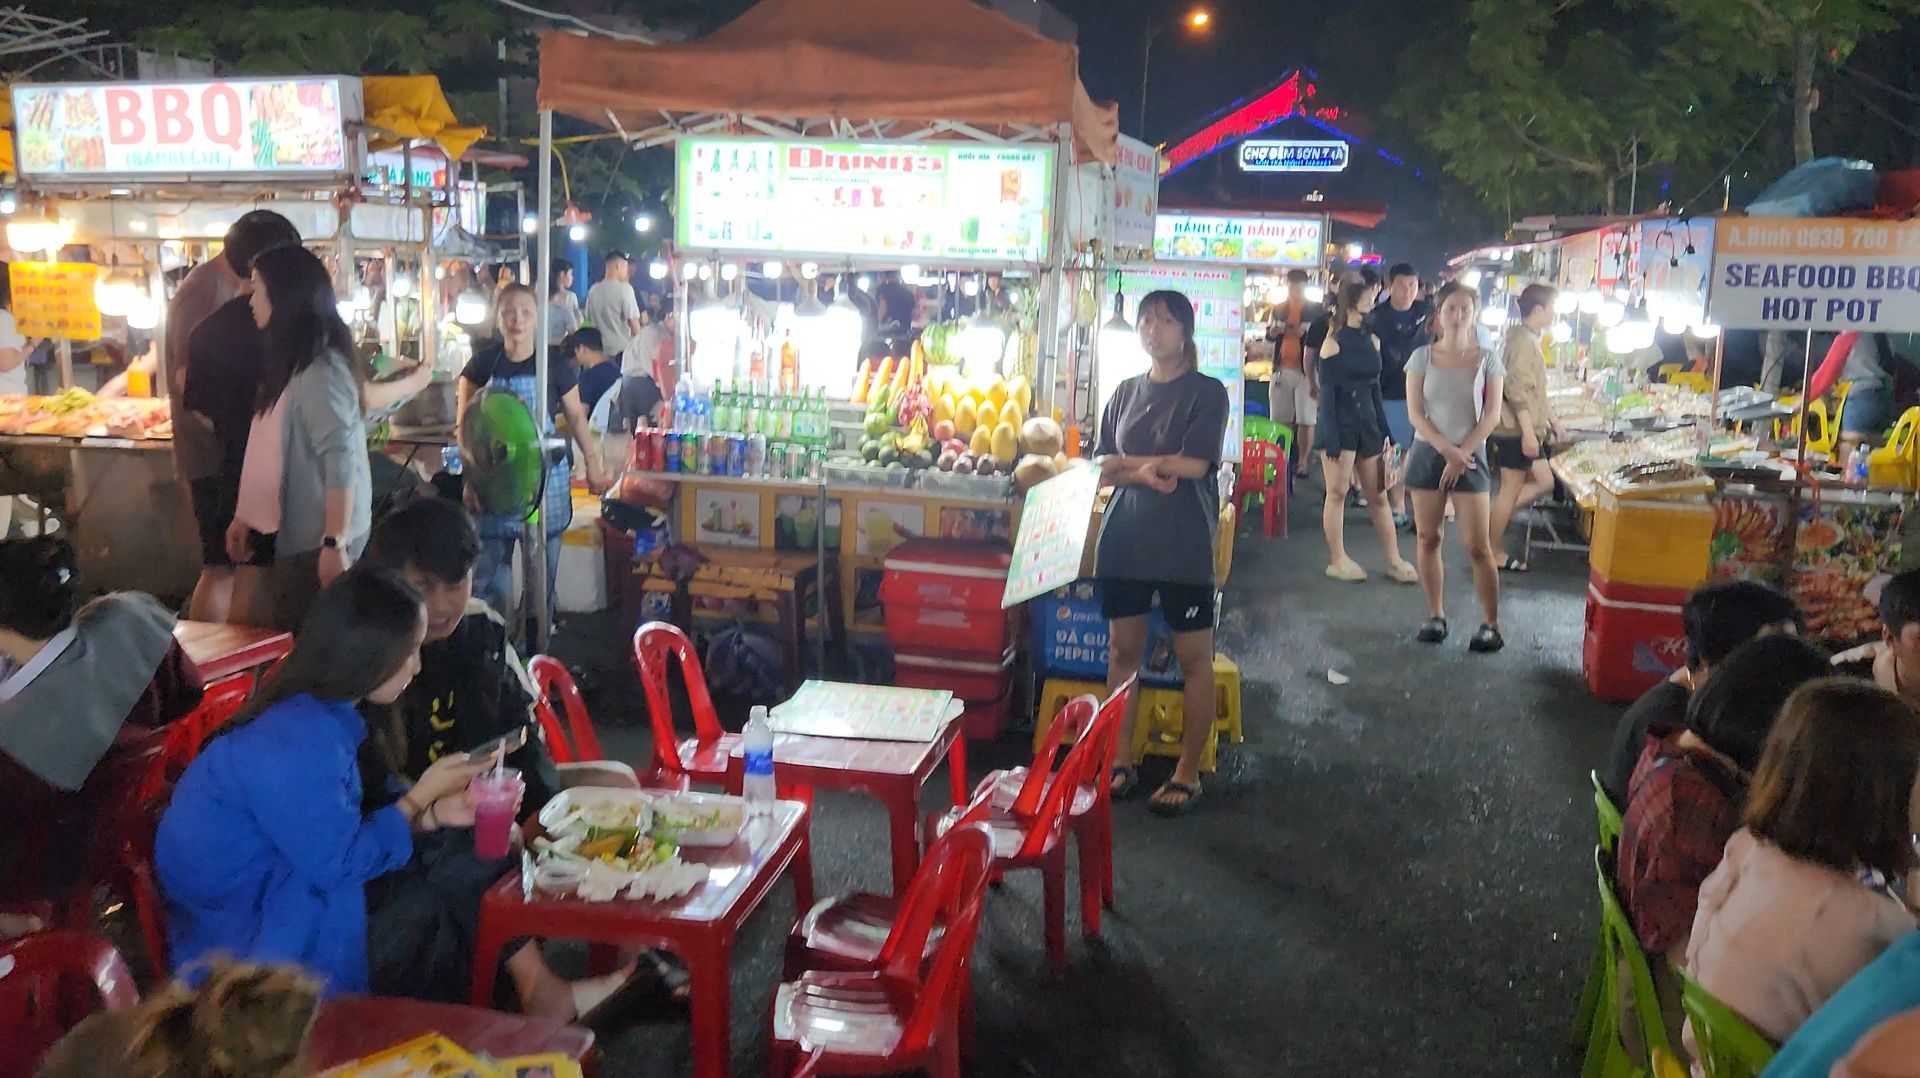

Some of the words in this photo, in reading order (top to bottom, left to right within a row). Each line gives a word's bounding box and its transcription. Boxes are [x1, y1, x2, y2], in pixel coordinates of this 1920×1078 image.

[105, 82, 242, 151] BBQ
[1174, 216, 1211, 234] BÁNH
[1725, 263, 1856, 289] SEAFOOD
[1866, 265, 1920, 293] BBQ
[1762, 297, 1818, 321] HOT
[1826, 299, 1882, 323] POT
[1055, 646, 1095, 663] PEPSI
